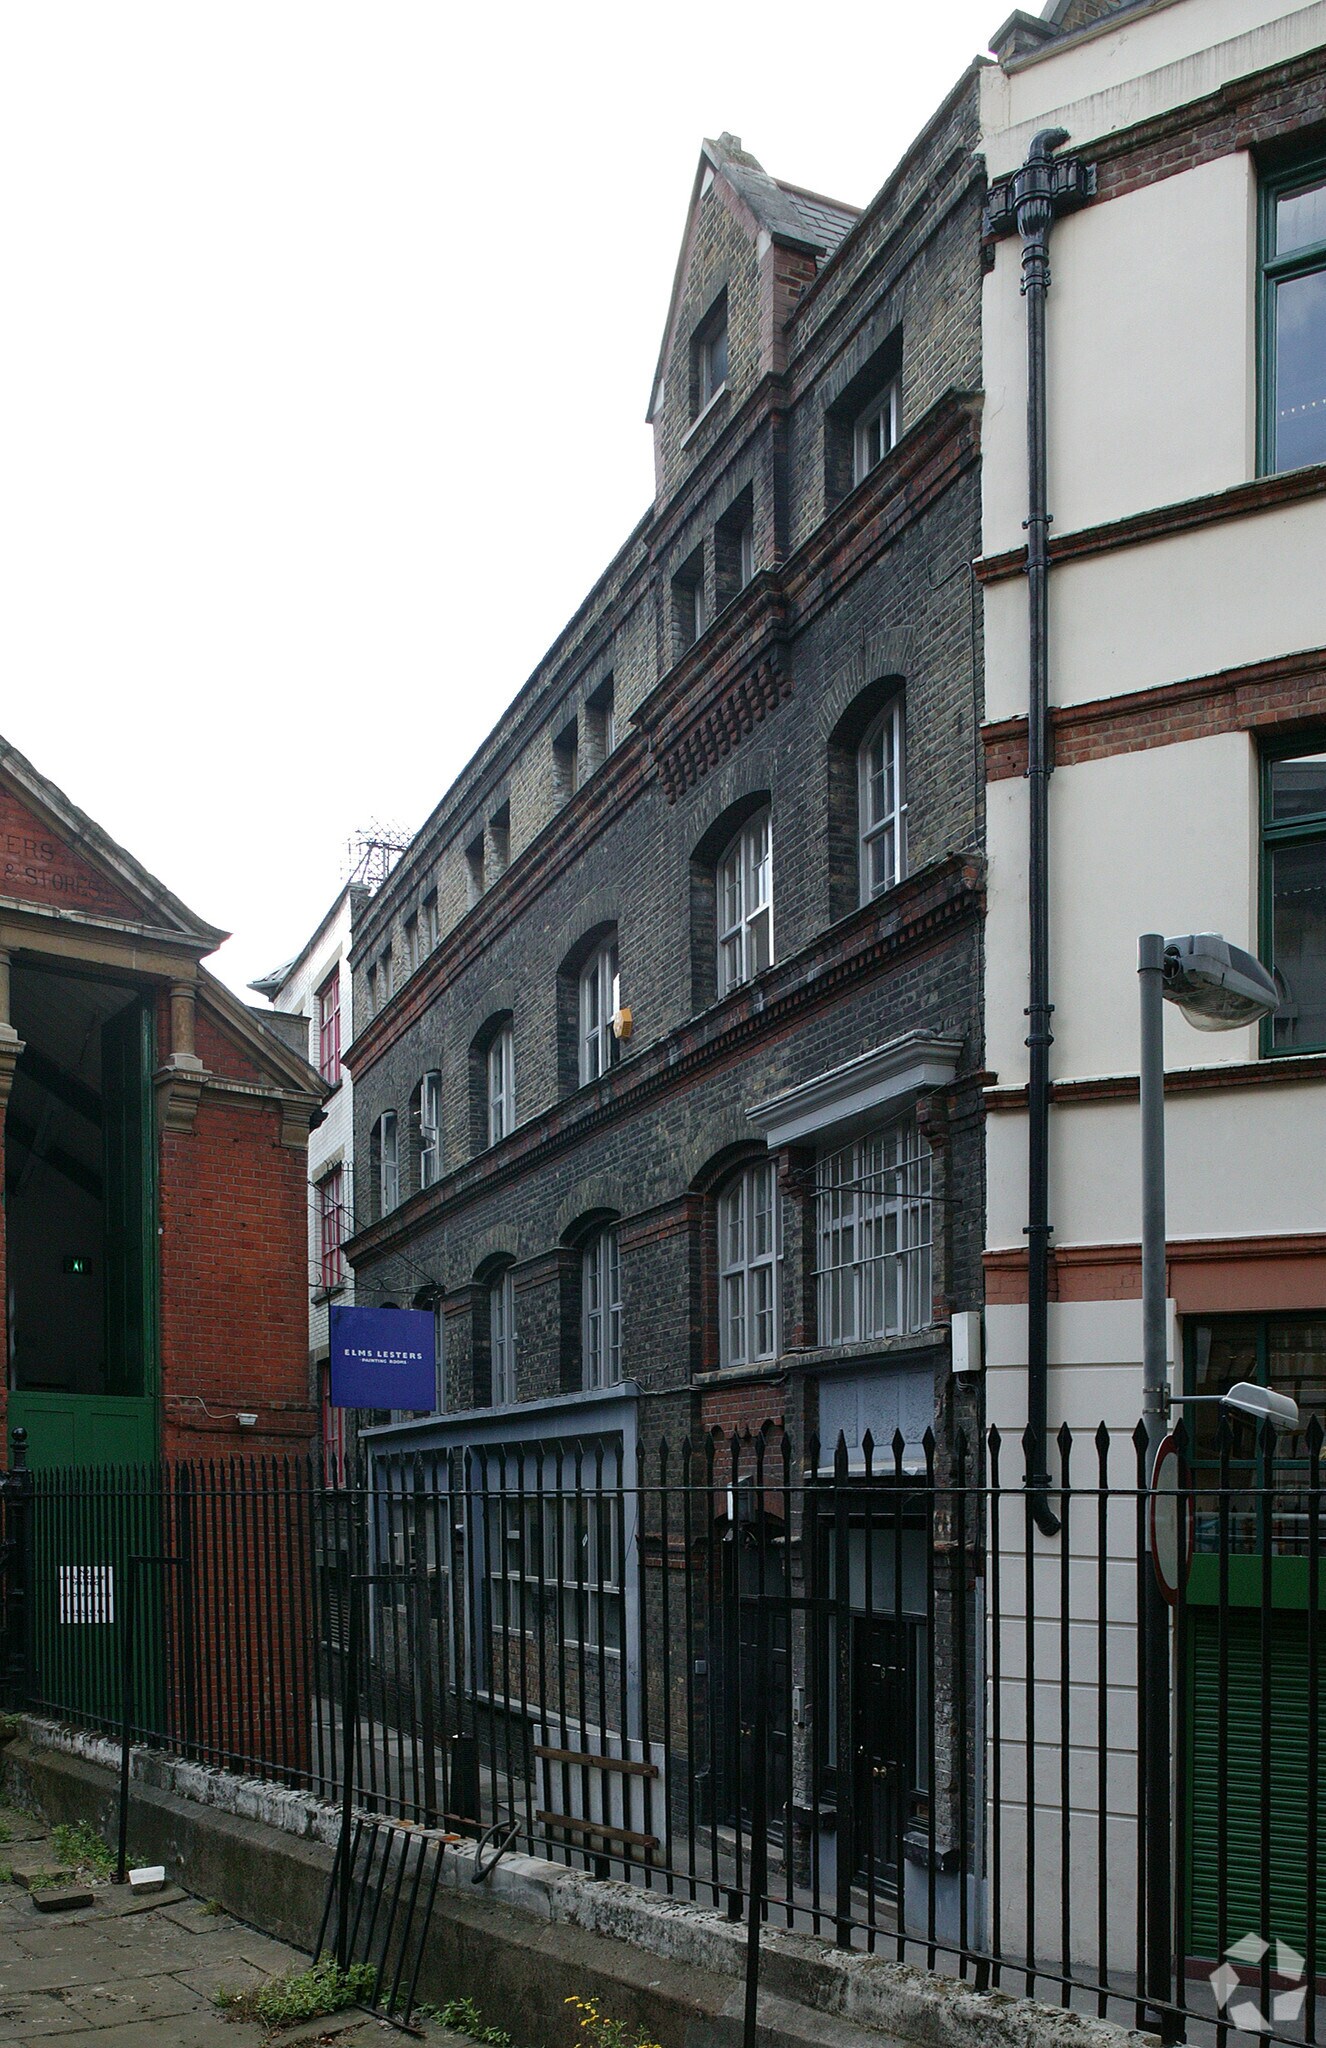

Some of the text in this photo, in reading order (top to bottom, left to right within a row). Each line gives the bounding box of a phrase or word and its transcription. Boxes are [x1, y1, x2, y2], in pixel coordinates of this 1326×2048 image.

[25, 867, 99, 898] STORES
[344, 1348, 423, 1360] ELMS LESTERS
